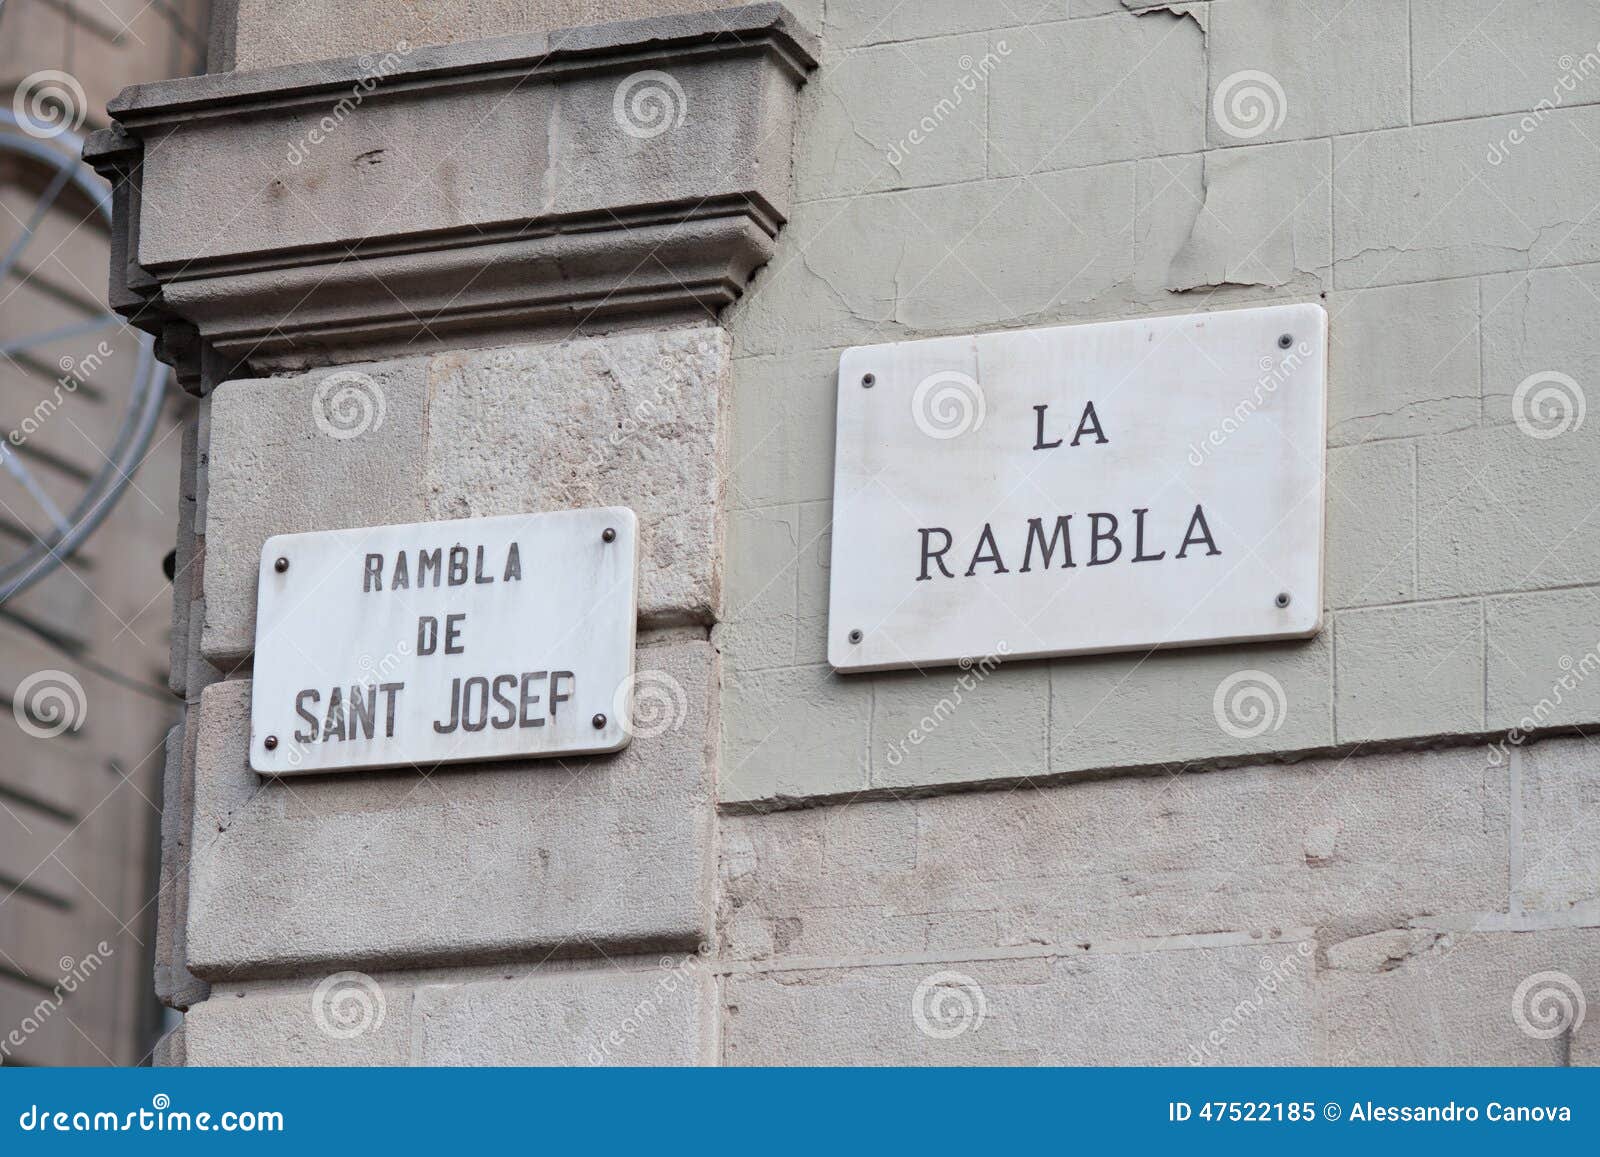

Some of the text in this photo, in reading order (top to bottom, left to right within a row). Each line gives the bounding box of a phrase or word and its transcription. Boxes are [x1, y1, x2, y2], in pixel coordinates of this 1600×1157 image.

[1033, 401, 1109, 450] LA
[363, 542, 522, 592] RAMBLA
[915, 504, 1223, 582] RAMBLA
[417, 613, 466, 656] DE
[294, 670, 575, 744] SANT JOSEP
